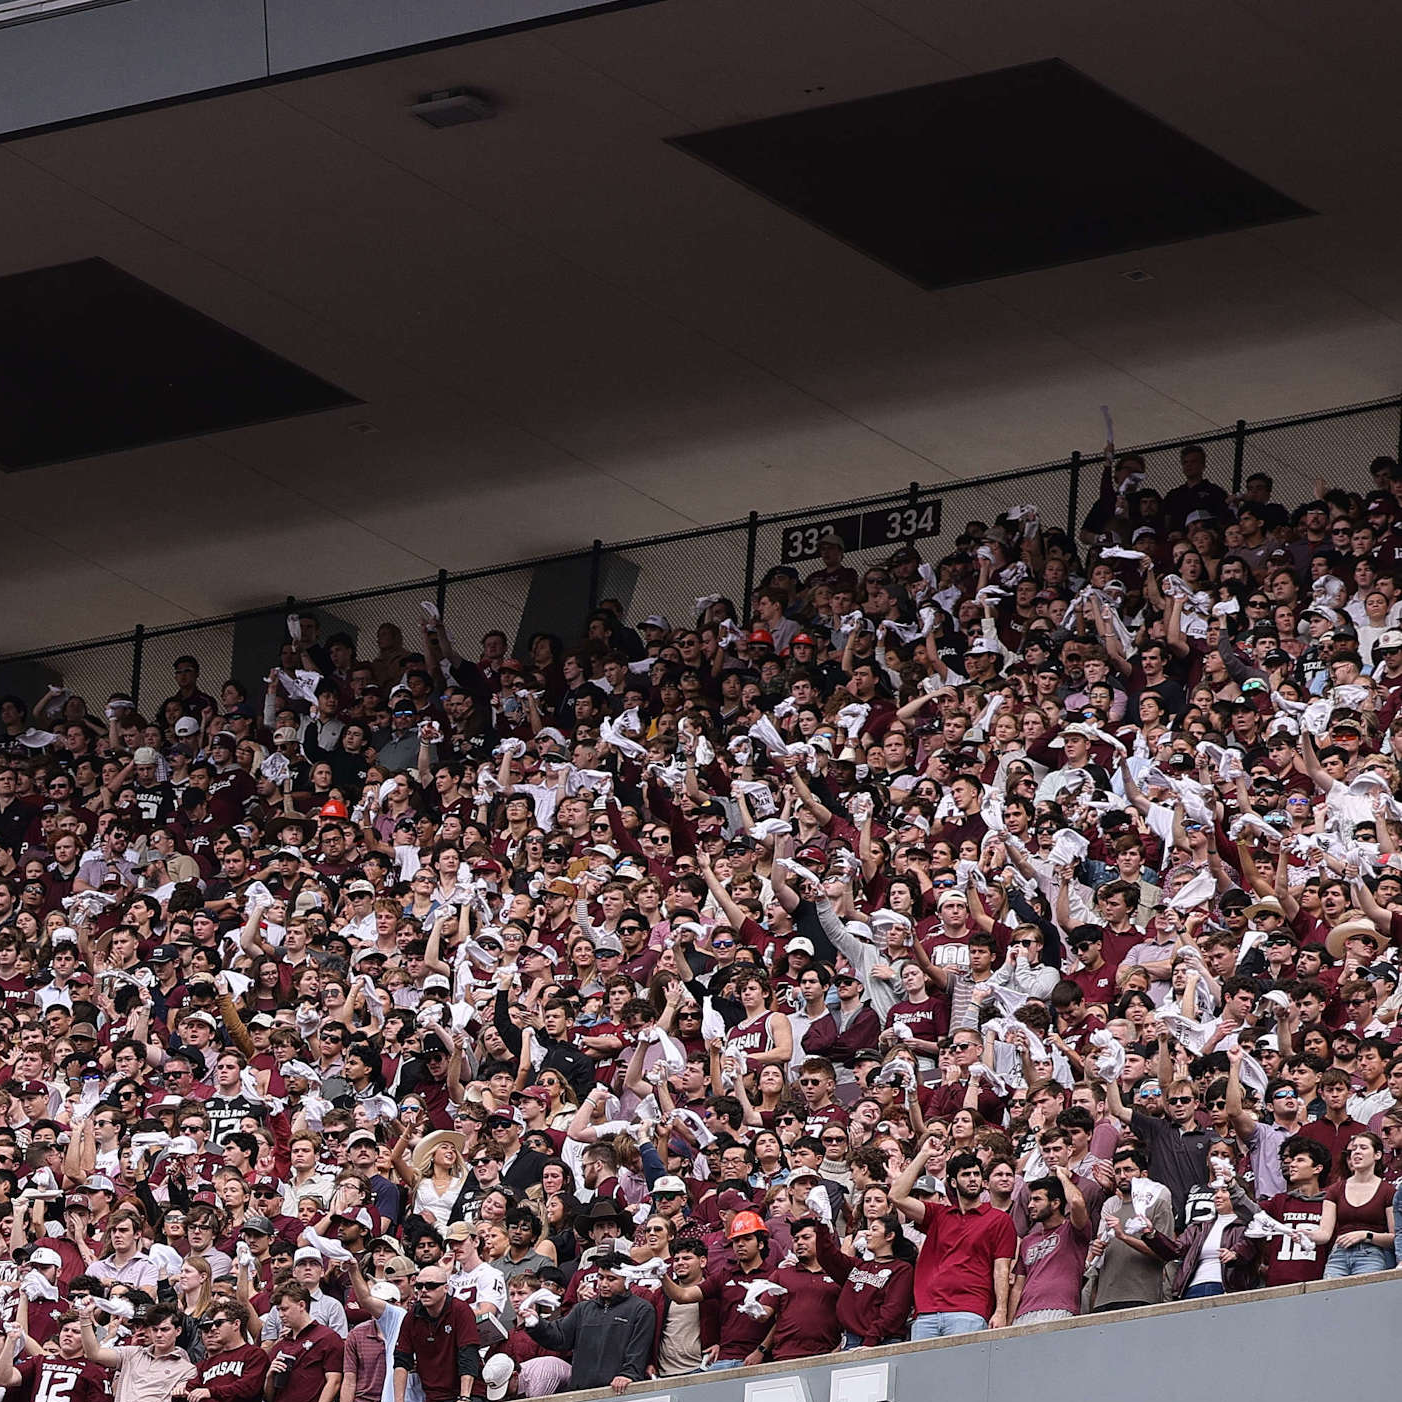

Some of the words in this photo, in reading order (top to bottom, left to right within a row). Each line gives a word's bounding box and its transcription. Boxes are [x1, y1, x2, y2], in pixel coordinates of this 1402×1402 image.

[886, 506, 934, 540] 334
[1283, 1212, 1306, 1222] TEXAS
[42, 1363, 61, 1372] TEXAS
